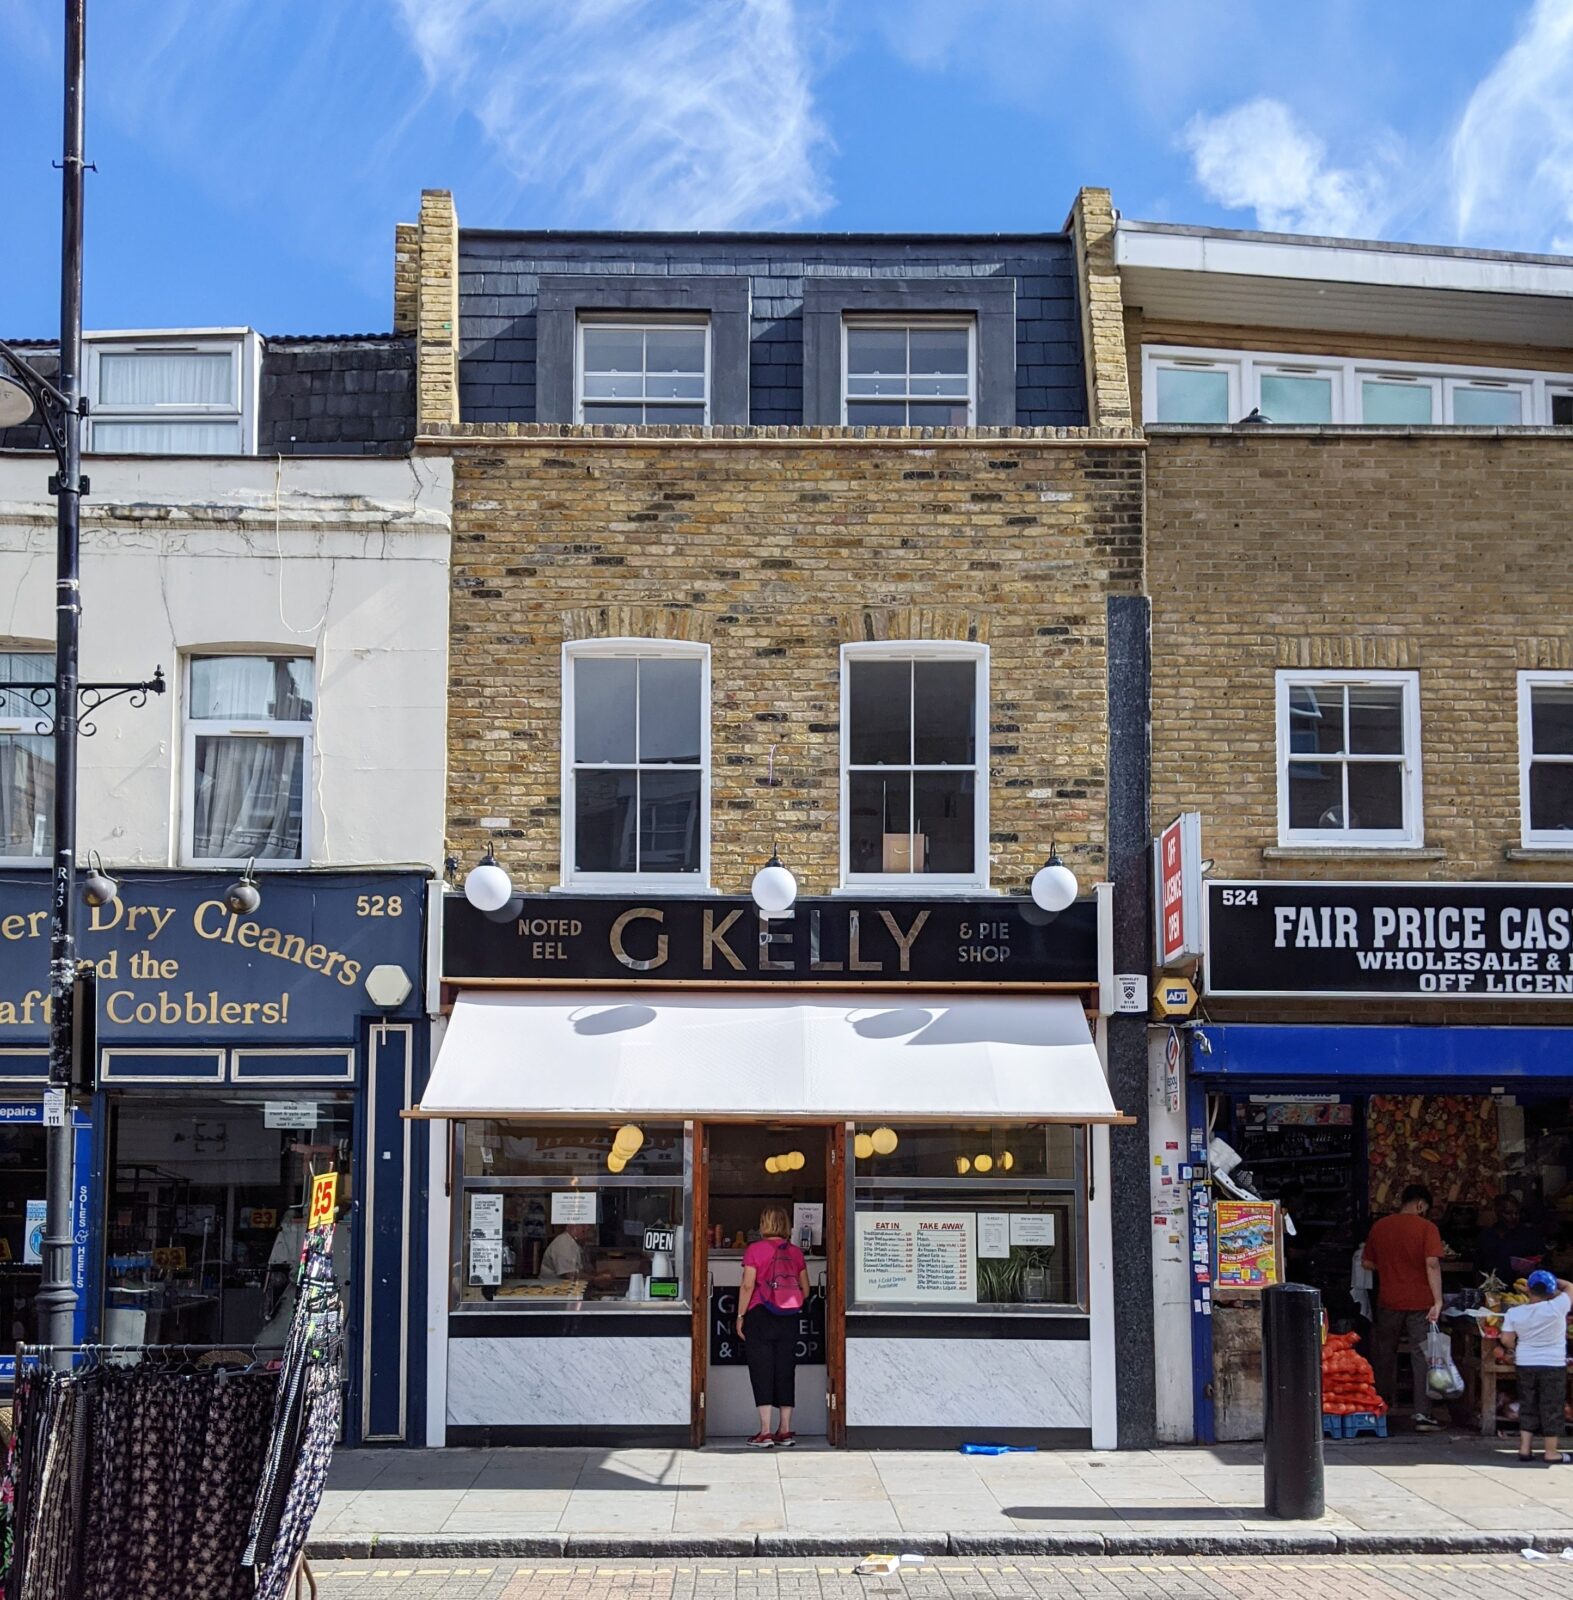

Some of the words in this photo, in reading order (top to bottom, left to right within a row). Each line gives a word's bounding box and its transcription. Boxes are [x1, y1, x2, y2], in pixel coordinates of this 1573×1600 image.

[1168, 837, 1176, 867] OFF
[1164, 870, 1182, 907] LICENCE
[1222, 890, 1259, 906] 524
[356, 895, 403, 917] 528
[518, 919, 582, 937] NOTED
[960, 922, 974, 940] &
[979, 922, 1010, 940] PIE
[1168, 911, 1180, 942] OPEN
[1274, 907, 1358, 948] FAIR
[1372, 907, 1486, 949] PRICE
[1500, 907, 1573, 950] CAS
[1, 911, 49, 940] er
[88, 895, 176, 941] Dry
[193, 900, 363, 987] Cleaners
[608, 908, 668, 970] G
[702, 909, 931, 971] KELLY
[532, 942, 567, 960] EEL
[957, 945, 1011, 964] SHOP
[1356, 952, 1538, 971] WHOLESALE
[1546, 953, 1561, 971] &
[129, 950, 179, 979] the
[1419, 974, 1475, 992] OFF
[1486, 974, 1573, 992] LICEN
[1167, 990, 1188, 1002] ADT
[106, 990, 290, 1025] Cobblers!
[79, 1185, 87, 1227] SOLES
[313, 1180, 333, 1216] £5
[74, 1229, 89, 1244] &
[645, 1232, 674, 1251] OPEN
[76, 1246, 85, 1288] HEELS
[717, 1294, 736, 1314] G
[718, 1341, 733, 1358] &
